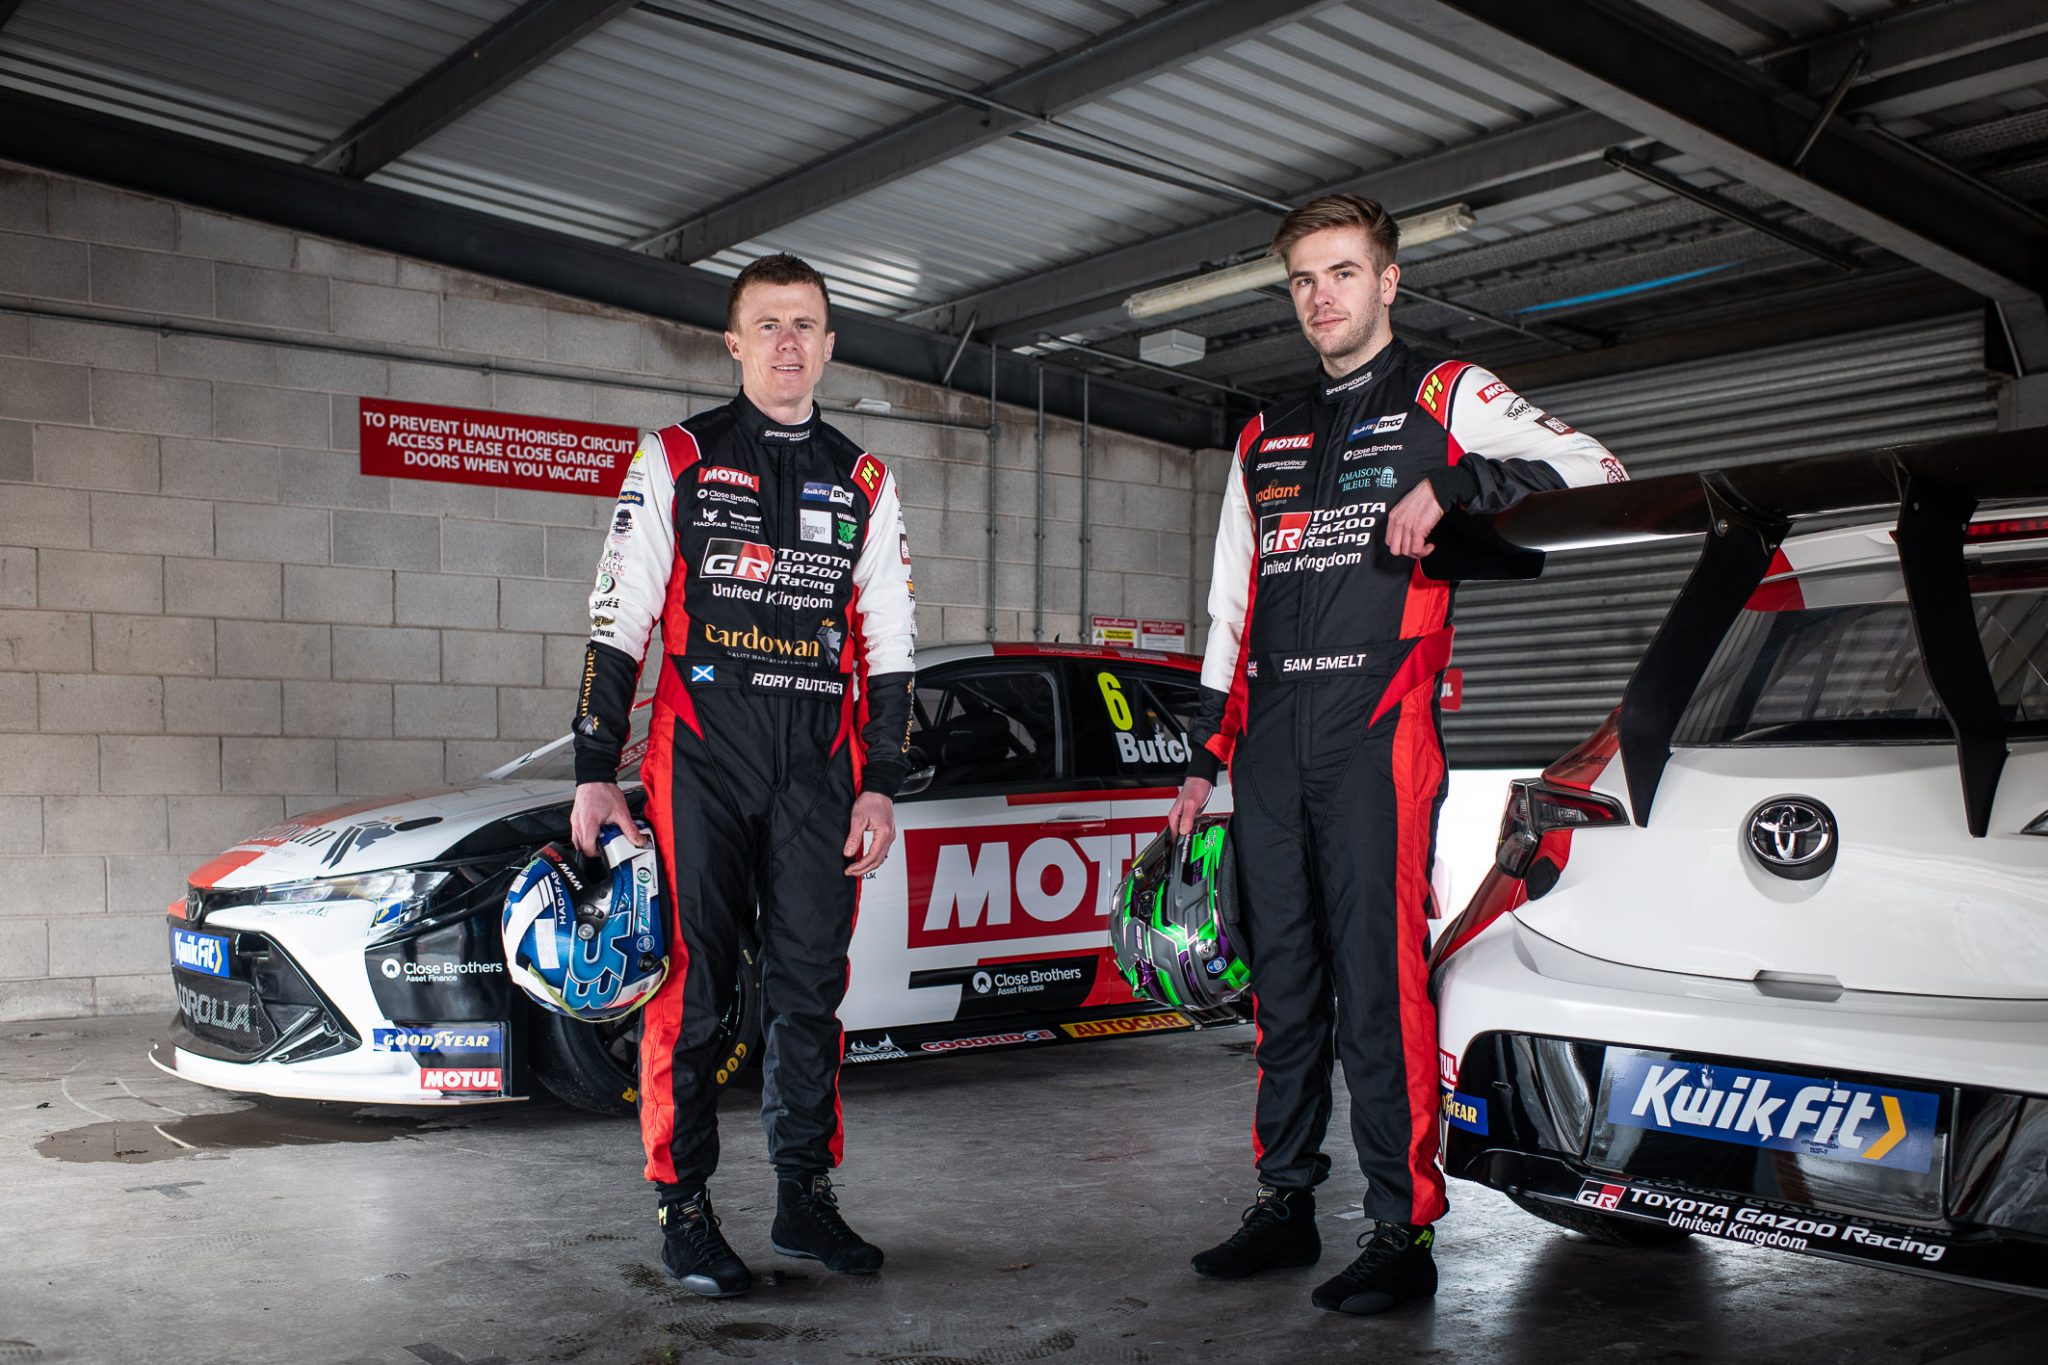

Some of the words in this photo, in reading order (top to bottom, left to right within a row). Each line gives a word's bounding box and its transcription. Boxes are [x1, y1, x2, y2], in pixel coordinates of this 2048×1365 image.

[363, 411, 385, 427] TO
[389, 414, 459, 436] PREVENT
[464, 421, 577, 447] UNAUTHORISED
[581, 434, 635, 454] CIRCUIT
[1379, 418, 1402, 428] BTCC
[387, 431, 444, 451] ACCESS
[448, 438, 503, 457] PLEASE
[506, 444, 552, 462] CLOSE
[555, 450, 615, 468] GARAGE
[1264, 436, 1309, 451] MOTUL
[1353, 447, 1371, 456] Close
[1371, 444, 1403, 452] Brothers
[404, 450, 460, 469] DOORS
[463, 457, 509, 474] WHEN
[512, 461, 543, 478] YOU
[546, 465, 600, 483] VACATE
[1256, 460, 1307, 471] SPEEDWORKS
[1345, 467, 1381, 483] MAISON
[704, 469, 754, 488] MOTUL
[1343, 478, 1370, 491] BLEUE
[709, 490, 730, 499] Close
[730, 493, 759, 506] Brothers
[1256, 484, 1301, 504] radiant
[1262, 528, 1301, 553] GR
[1313, 502, 1386, 523] TOYOTA
[1307, 517, 1375, 536] GAZOO
[1302, 532, 1370, 549] Racing
[704, 554, 770, 581] GR
[778, 548, 851, 569] TOYOTA
[775, 561, 842, 580] GAZOO
[1295, 552, 1361, 573] Kingdom
[771, 573, 835, 594] Racing
[712, 583, 763, 602] United
[766, 591, 833, 610] Kingdom
[705, 624, 819, 657] Cardowan
[1283, 657, 1312, 672] SAM
[1315, 653, 1366, 671] SMELT
[752, 673, 794, 689] RORY
[795, 677, 843, 695] BUTCHER
[1098, 672, 1133, 731] 6
[923, 831, 1158, 931] MOT
[551, 871, 567, 925] HAD-FAB
[404, 960, 440, 975] Close
[444, 960, 503, 974] Brothers
[995, 970, 1029, 988] Close
[1031, 967, 1081, 983] Brothers
[427, 974, 458, 982] Finance
[997, 986, 1020, 996] Asset
[1022, 983, 1044, 994] Finance
[1076, 1013, 1181, 1037] AUTOCAR
[383, 1031, 489, 1049] GOODYEAR
[921, 1029, 1057, 1052] GOODRIDGE
[424, 1071, 499, 1088] MOTUL
[1577, 1190, 1618, 1209] GR
[1630, 1187, 1728, 1218] TOYOTA
[1735, 1207, 1836, 1237] GAZOO
[1841, 1226, 1946, 1261] Racing
[1668, 1212, 1722, 1235] United
[1726, 1223, 1808, 1250] Kingdom
